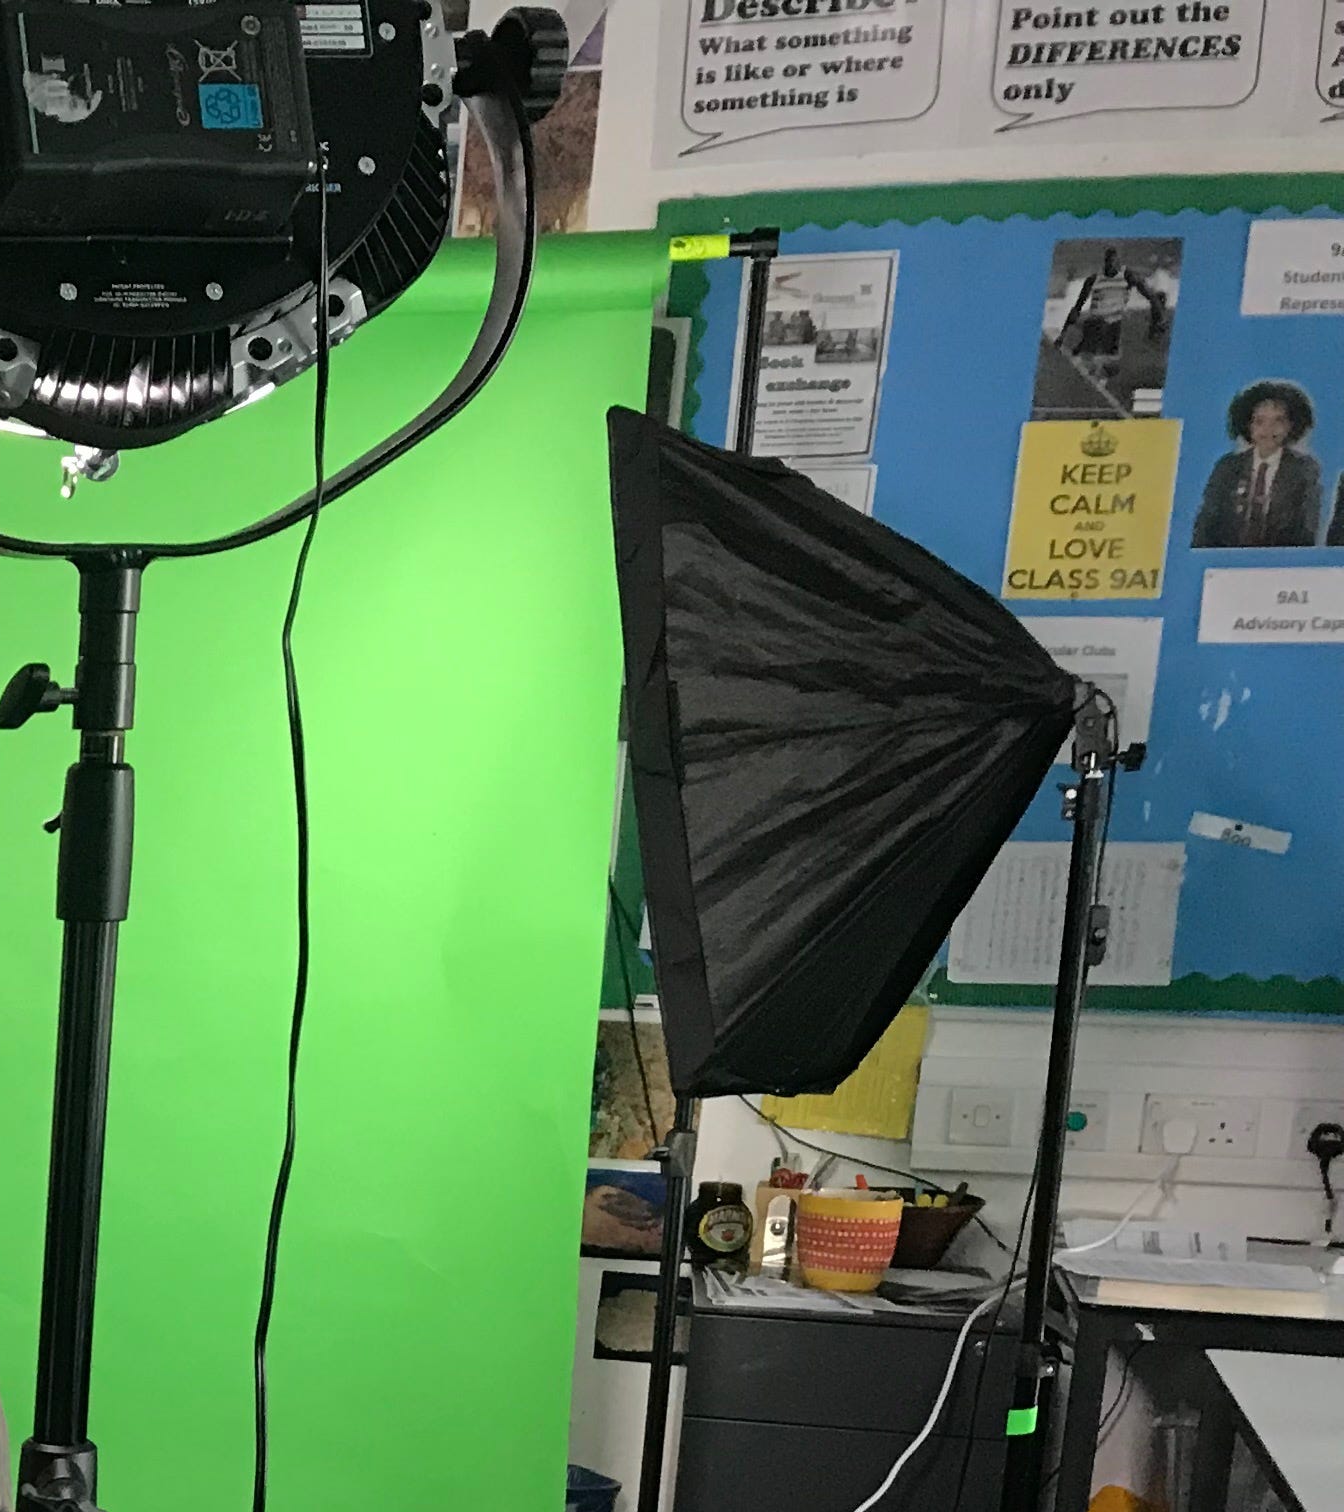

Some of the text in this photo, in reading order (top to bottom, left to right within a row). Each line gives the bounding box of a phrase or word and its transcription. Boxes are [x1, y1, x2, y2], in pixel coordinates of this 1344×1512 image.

[1011, 1, 1230, 31] Point out the
[699, 24, 913, 55] What something
[1007, 34, 1242, 65] DIFFERENCES
[696, 55, 904, 85] is like or where
[693, 84, 859, 114] something is
[1003, 78, 1075, 104] only
[1280, 296, 1344, 312] Represe
[1061, 463, 1132, 485] KEEP
[1050, 493, 1136, 516] CALM
[1073, 521, 1105, 532] AND
[1048, 538, 1125, 560] LOVE
[1008, 568, 1160, 590] CLASS 9A1
[1232, 616, 1306, 633] Advisory
